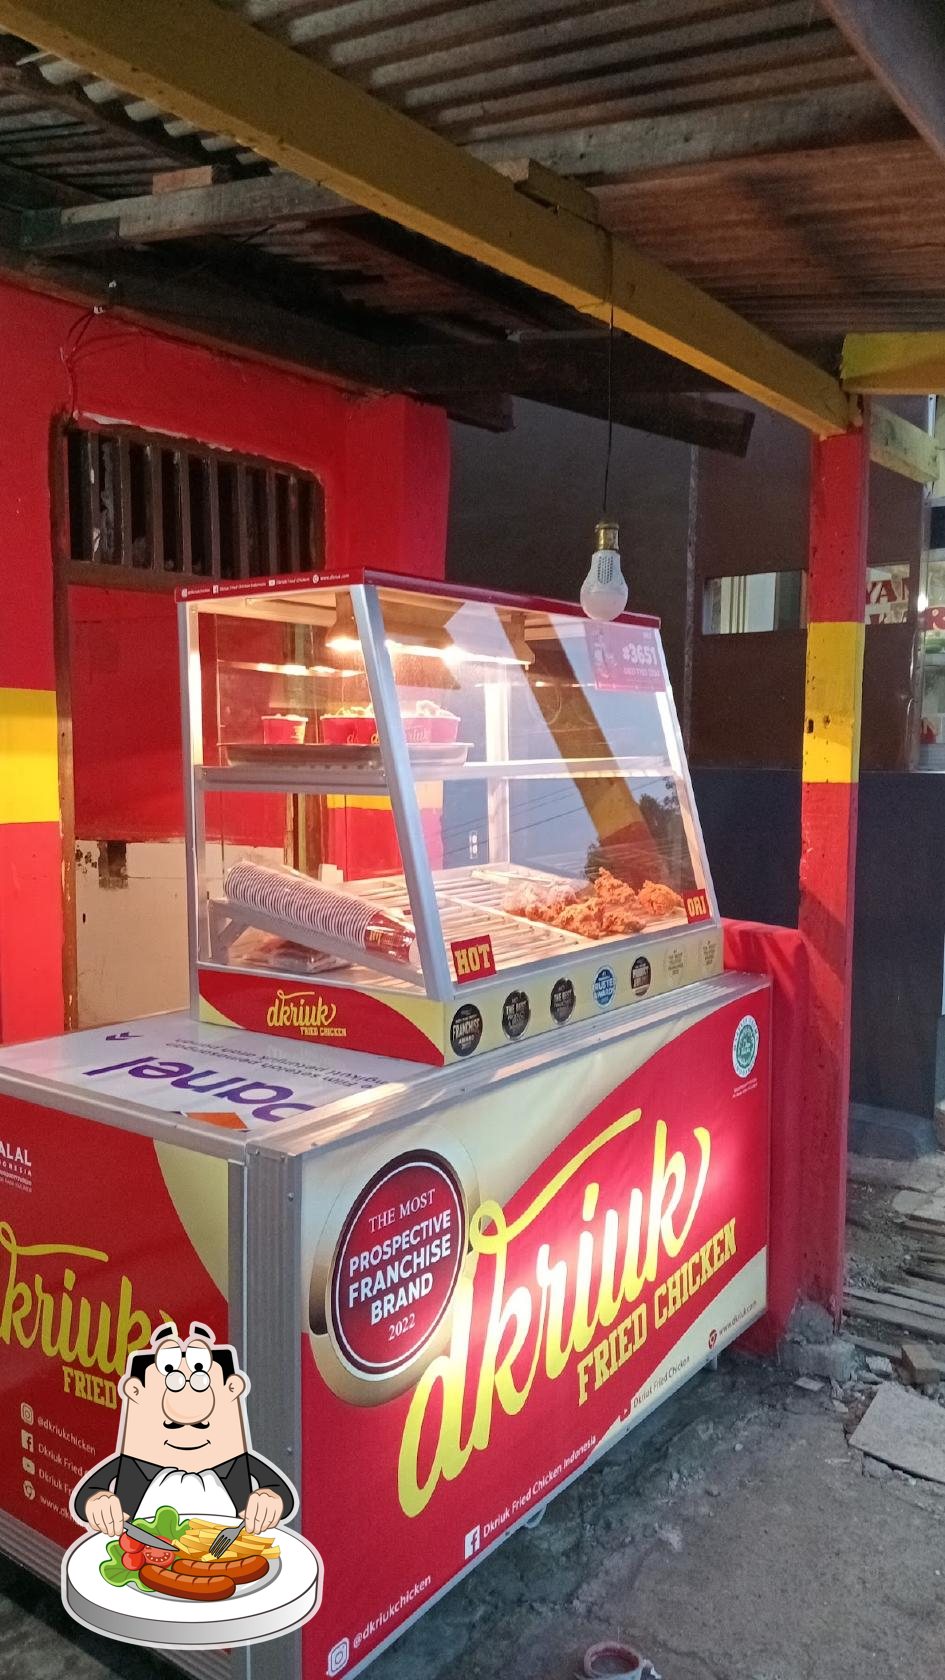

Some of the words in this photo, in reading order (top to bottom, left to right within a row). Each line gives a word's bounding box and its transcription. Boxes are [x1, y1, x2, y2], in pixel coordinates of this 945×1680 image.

[454, 944, 491, 976] HOT
[266, 989, 337, 1027] dkriuk
[320, 1027, 347, 1037] CHICKEN
[369, 1208, 396, 1233] THE
[399, 1188, 436, 1219] MOST
[349, 1209, 451, 1278] PROSPECTIVE
[348, 1233, 451, 1309] FRANCHISE
[370, 1272, 433, 1326] BRAND
[397, 1107, 711, 1519] dkriuk
[577, 1302, 648, 1407] FRIED
[653, 1219, 737, 1330] CHICKEN
[387, 1313, 416, 1342] 2022
[62, 1365, 118, 1411] FRIED
[652, 1374, 668, 1391] Fried
[37, 1416, 97, 1457] @dkriukchicken
[38, 1443, 63, 1465] Dkriuk
[63, 1457, 83, 1477] Fried
[38, 1468, 64, 1490] Dkriuk
[482, 1507, 511, 1539] Dkriuk
[511, 1488, 532, 1515] Fried
[531, 1463, 562, 1496] Chicken
[562, 1434, 598, 1469] Indonesia
[353, 1575, 432, 1649] @dkriukchicken
